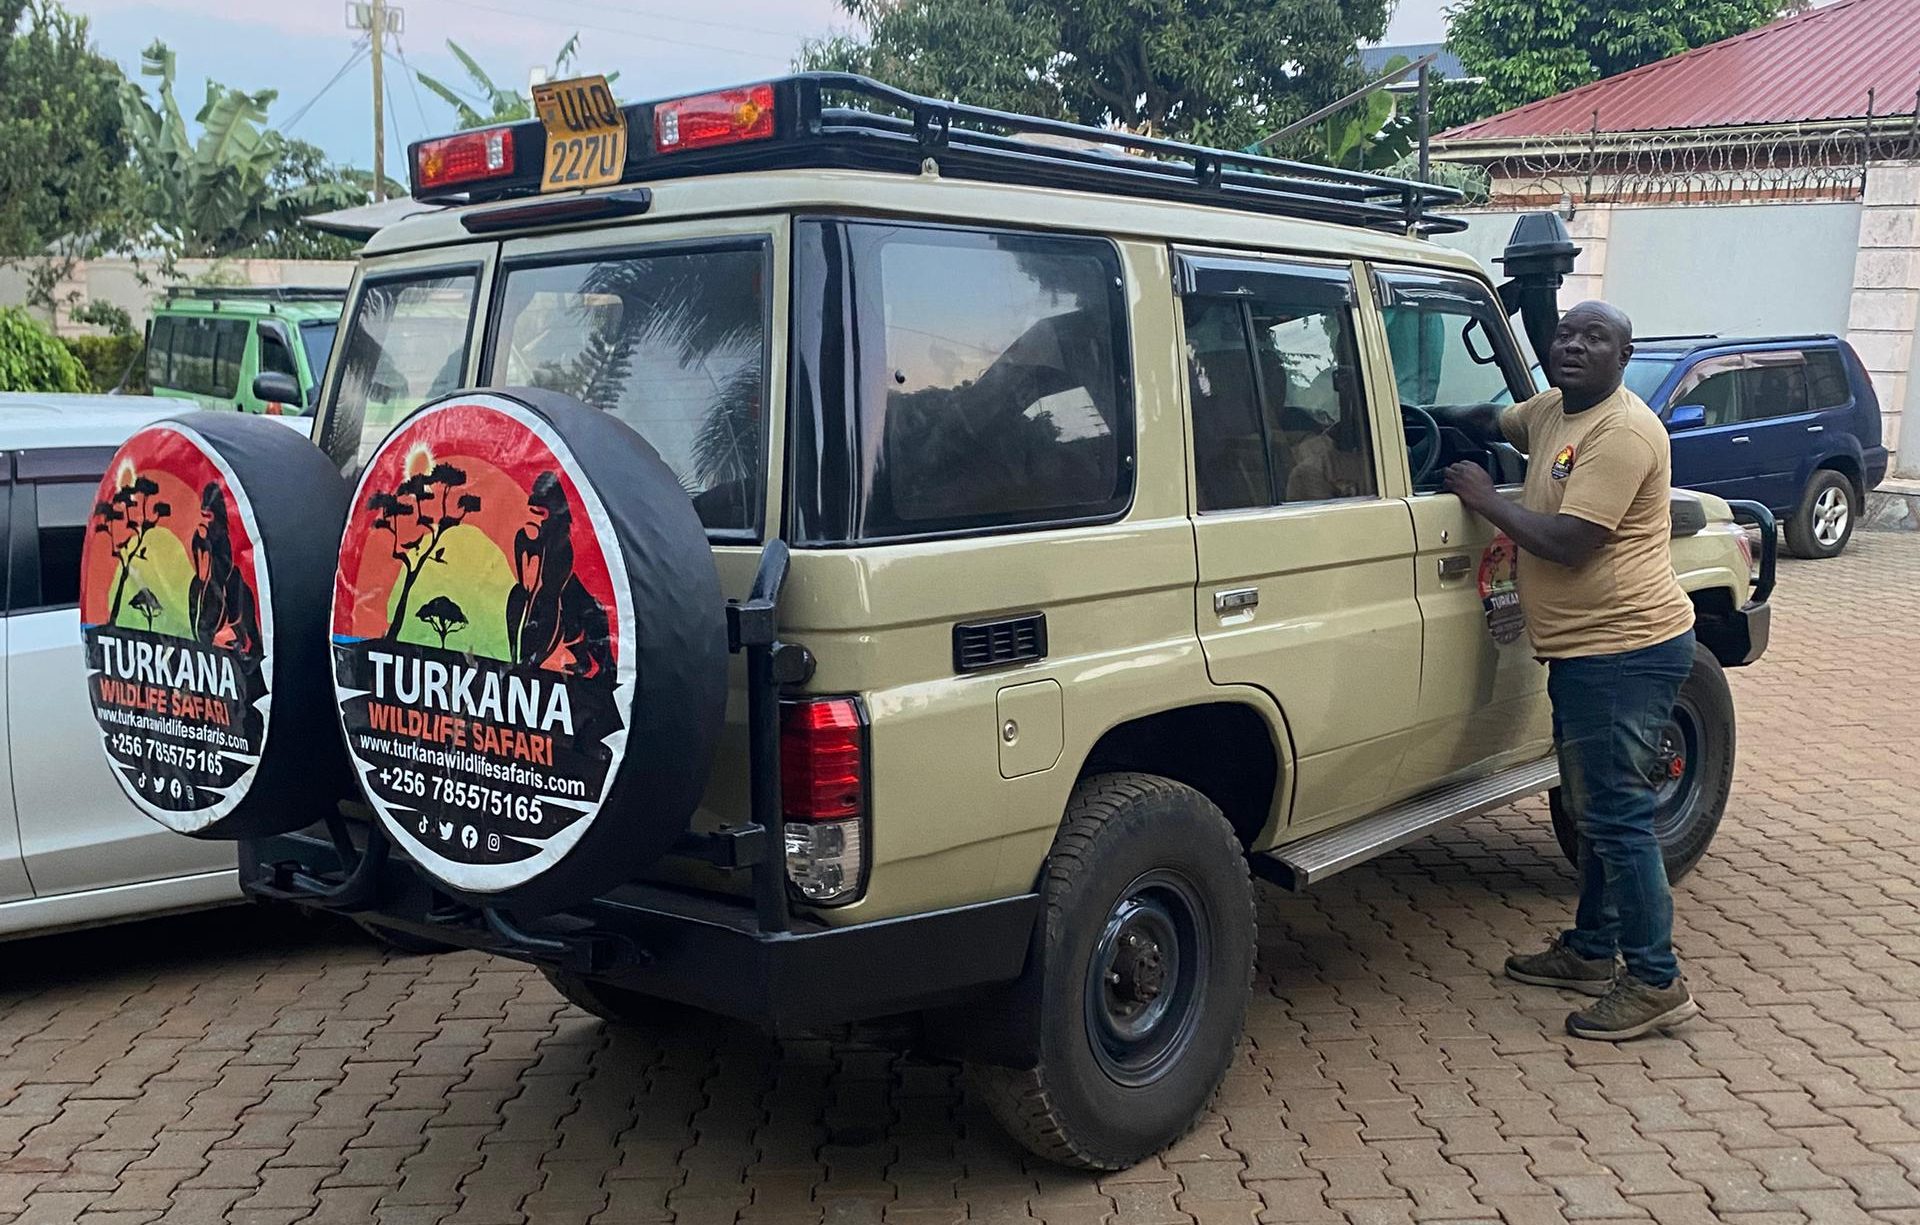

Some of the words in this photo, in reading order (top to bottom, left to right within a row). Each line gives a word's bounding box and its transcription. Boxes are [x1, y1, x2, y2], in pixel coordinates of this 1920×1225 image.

[556, 85, 619, 132] UAQ
[549, 133, 617, 183] 227U
[98, 637, 238, 700] TURKANA
[368, 651, 574, 735] TURKANA
[100, 678, 166, 714] WILDLIFE
[172, 690, 230, 726] SAFARI
[98, 708, 248, 751] www.turkanawildlifesafaris.com
[112, 734, 142, 757] +256
[146, 738, 223, 776] 785575165
[368, 702, 466, 747] WILDLIFE
[472, 722, 553, 767] SAFARI
[360, 735, 585, 796] www.turkanawildlifesafaris.com
[380, 767, 425, 797] +256
[432, 776, 543, 824] 785575165
